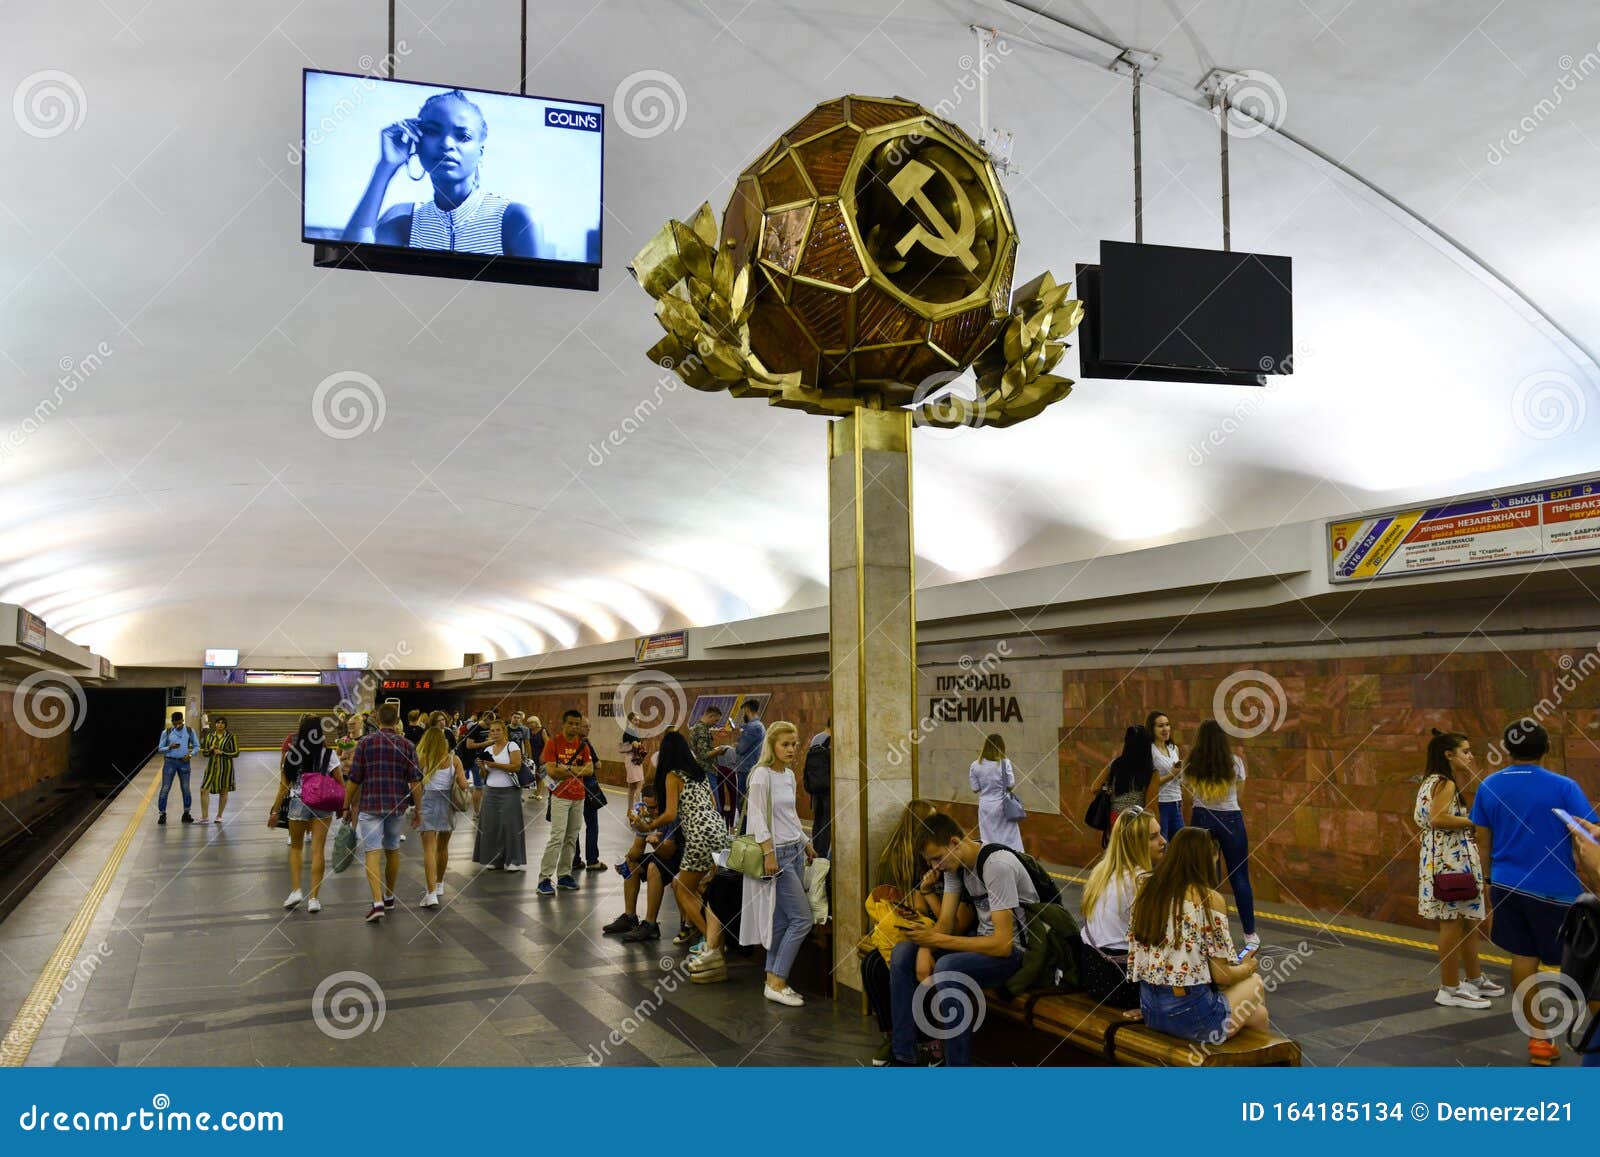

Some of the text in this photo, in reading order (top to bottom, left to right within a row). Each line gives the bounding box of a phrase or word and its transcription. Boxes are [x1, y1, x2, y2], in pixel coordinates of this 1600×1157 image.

[548, 112, 597, 129] COLIN'S
[1508, 488, 1572, 506] ВЫХАД EXIT
[1457, 510, 1531, 528] НЕЗАЛЕЖНАСЦІ
[936, 673, 1011, 691] ПЛОЩАДЬ
[929, 696, 1023, 723] ЛЕНИНА
